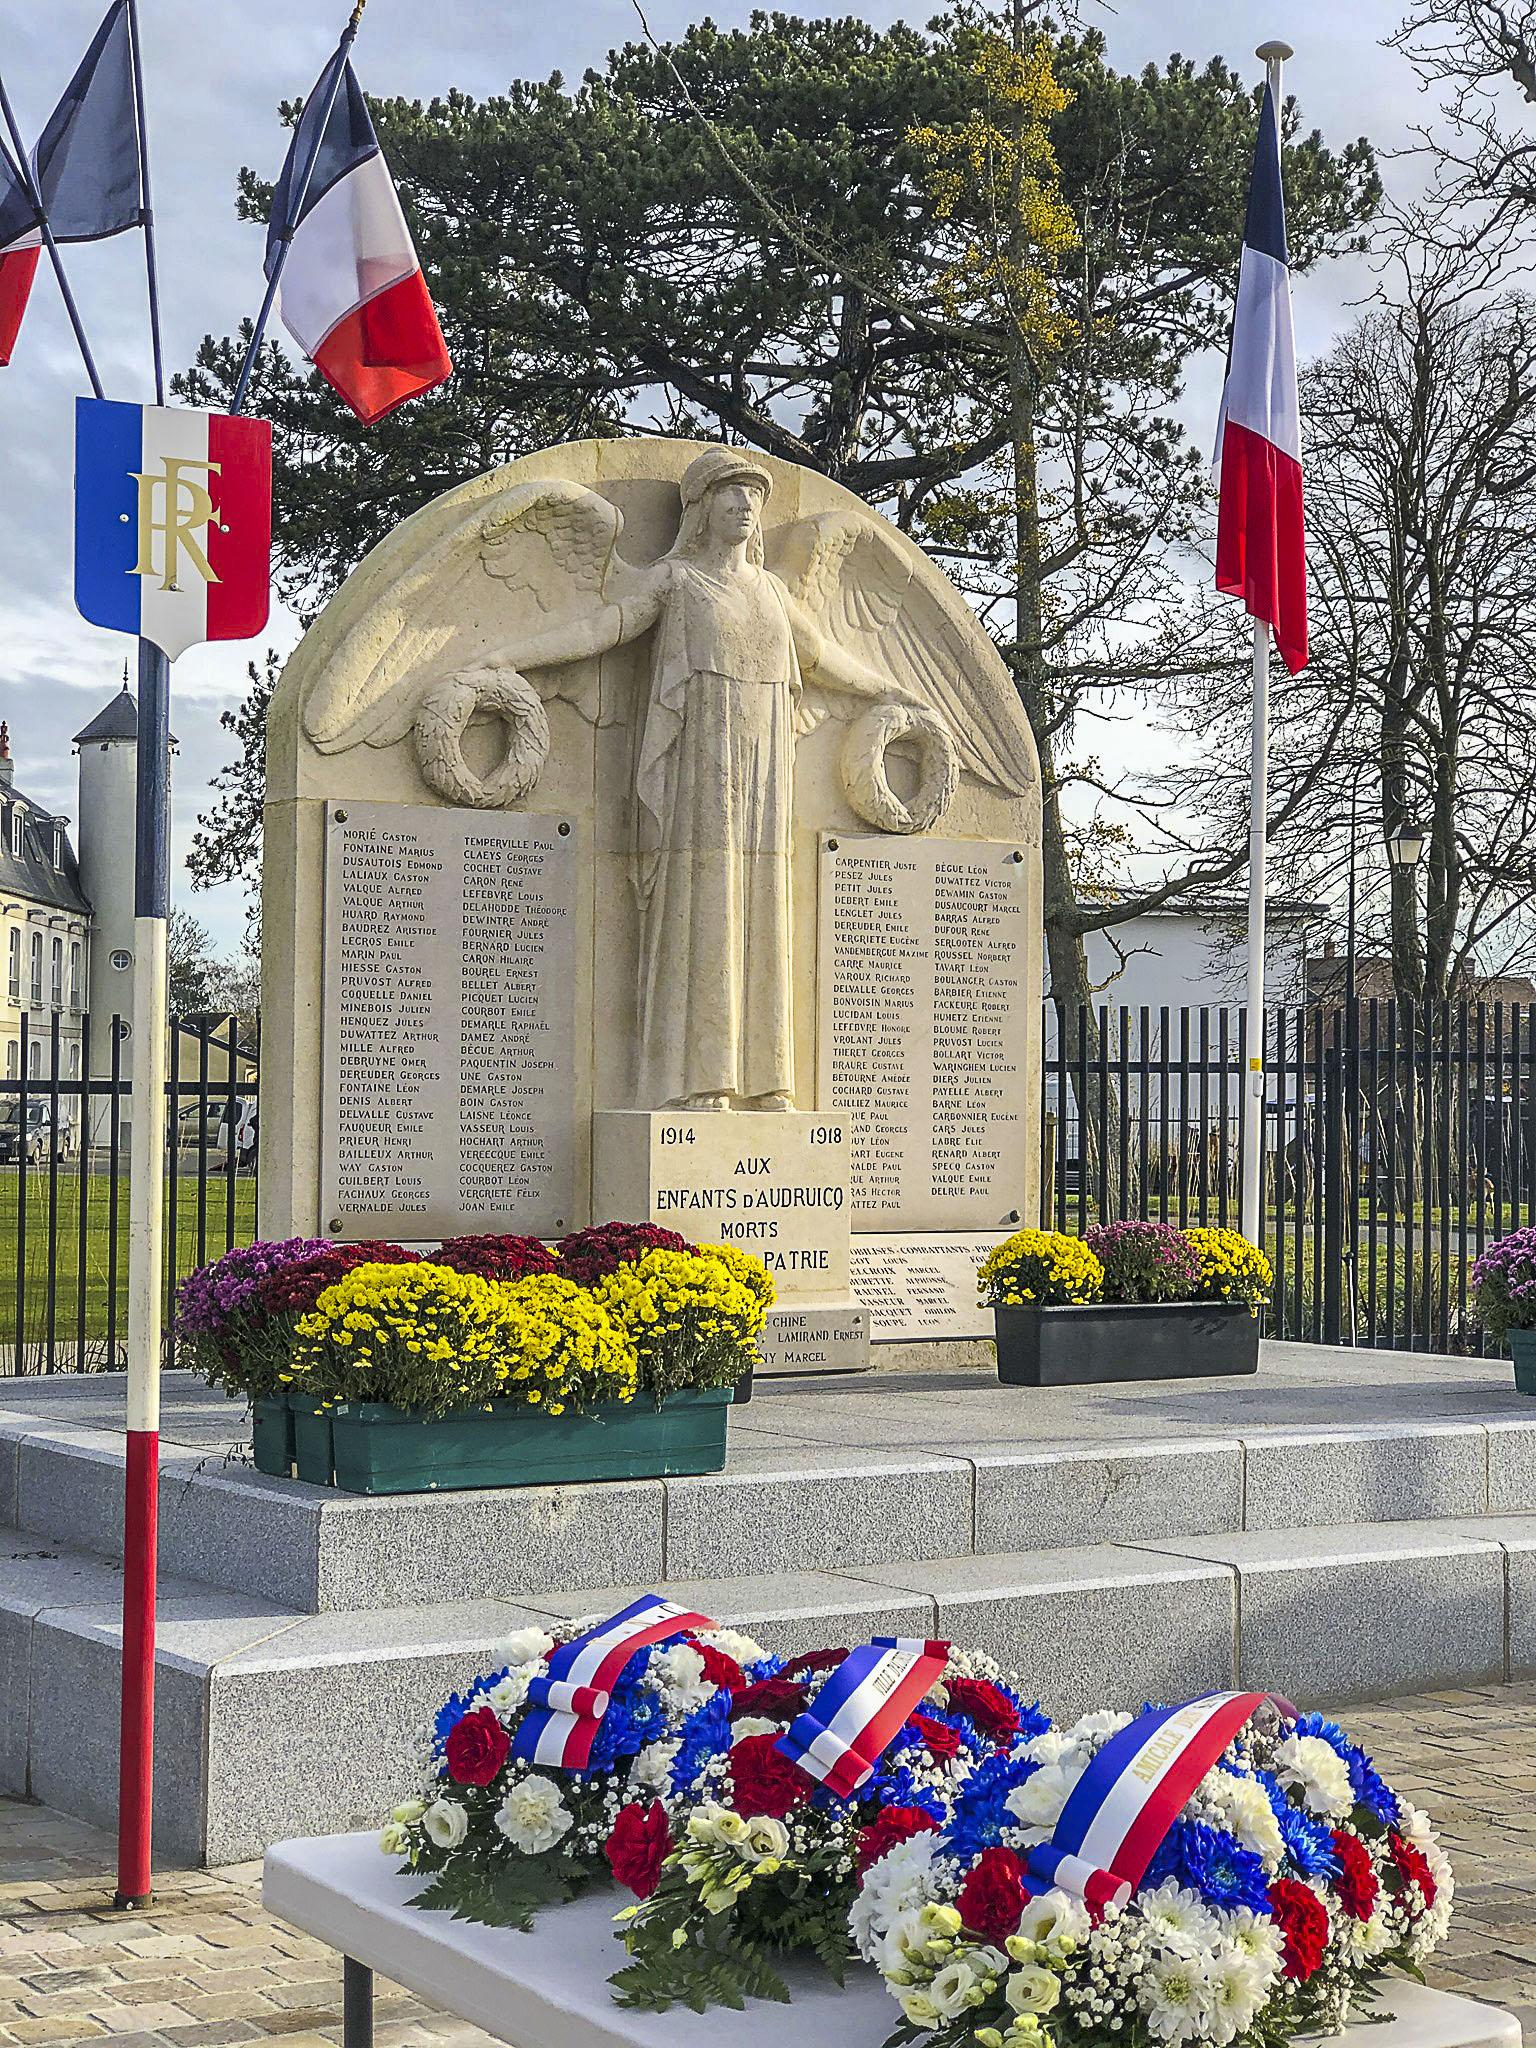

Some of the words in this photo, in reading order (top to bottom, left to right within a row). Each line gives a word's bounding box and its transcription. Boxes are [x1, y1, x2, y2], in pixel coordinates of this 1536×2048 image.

[464, 836, 529, 850] TEMPERVILLE
[534, 841, 555, 851] PAUL
[343, 843, 394, 855] FONTAINE
[399, 846, 435, 858] MARIUS
[343, 856, 402, 869] DUSAUTOIS
[407, 860, 443, 871] EDMOND
[463, 863, 502, 874] COCHET
[463, 875, 496, 888] CARON
[343, 883, 382, 895] VALQUE
[388, 885, 423, 897] ALFRED
[463, 889, 513, 902] LEFEBVRE
[518, 891, 544, 902] LOUIS
[343, 896, 383, 908] VALQUE
[388, 899, 425, 911] ARTHUR
[463, 902, 520, 914] DELAHODDE
[342, 909, 378, 922] HUARD
[383, 911, 425, 922] RAYMOND
[462, 915, 516, 928] DEWINTRE
[342, 922, 390, 935] BAUDREZ
[395, 925, 437, 936] ARISTIDE
[462, 927, 513, 941] FOURNIER
[517, 930, 544, 940] JULES
[462, 940, 510, 953] BERNARD
[514, 943, 544, 953] LUCIEN
[341, 949, 375, 961] MARIN
[380, 950, 402, 961] PAUL
[462, 953, 495, 965] CARON
[500, 955, 534, 967] HILAIRE
[341, 962, 380, 973] HIESSE
[462, 967, 501, 979] BOUREL
[506, 968, 538, 980] ERNEST
[341, 976, 392, 987] PRUVOST
[397, 978, 432, 989] ALFRED
[462, 980, 499, 990] BELLET
[503, 981, 537, 993] ALBERT
[341, 989, 395, 1001] COQUELLE
[400, 991, 433, 1001] DANIEL
[461, 993, 504, 1004] PICQUET
[508, 994, 539, 1004] LUCIEN
[341, 1003, 392, 1013] MINEBOIS
[398, 1004, 431, 1014] JULIEN
[461, 1006, 506, 1018] COURBOT
[341, 1016, 389, 1028] HENQUEZ
[395, 1017, 424, 1028] JULES
[461, 1019, 507, 1031] DEMARLE
[340, 1029, 397, 1040] DUWATTEZ
[402, 1031, 440, 1043] ARTHUR
[461, 1032, 495, 1043] DAMEZ
[340, 1043, 373, 1053] MILLE
[379, 1044, 415, 1056] ALFRED
[500, 1047, 535, 1058] ARTHUR
[340, 1056, 396, 1068] DEBRUYNE
[401, 1057, 427, 1069] OMER
[460, 1058, 517, 1070] PAQUENTIN
[521, 1059, 554, 1069] JOSEPH
[340, 1069, 395, 1081] DEREUDER
[340, 1082, 391, 1093] FONTAINE
[460, 1084, 507, 1097] DEMARLE
[511, 1085, 544, 1095] JOSEPH
[340, 1096, 371, 1106] DENIS
[377, 1097, 413, 1107] ALBERT
[460, 1097, 484, 1107] BOIN
[339, 1109, 390, 1119] DELVALLE
[339, 1122, 393, 1134] FAUQUEUR
[460, 1124, 506, 1135] VASSEUR
[510, 1124, 535, 1133] LOUIS
[339, 1136, 380, 1148] PRIEUR
[384, 1136, 412, 1148] HENRI
[660, 1127, 696, 1145] 1914
[810, 1127, 842, 1145] 1918
[460, 1137, 505, 1148] HOCHART
[510, 1137, 544, 1148] ARTHUR
[338, 1149, 392, 1159] BAILLEUX
[397, 1150, 434, 1161] ARTHUR
[338, 1163, 362, 1172] WAY
[459, 1163, 516, 1174] COCQUEREZ
[734, 1158, 771, 1175] AUX
[395, 1176, 422, 1186] LOUIS
[459, 1176, 504, 1186] COURBOT
[338, 1189, 386, 1199] FACHAUX
[657, 1188, 737, 1210] ENFANTS
[399, 1203, 427, 1212] JULES
[720, 1222, 778, 1239] MORTS
[763, 1250, 829, 1271] PATRIE
[772, 1316, 807, 1328] CHINE
[778, 1330, 829, 1343] LAMIRAND
[833, 1329, 864, 1341] ERNEST
[784, 1351, 827, 1363] MARCEL
[1131, 1728, 1184, 1784] AMICALE
